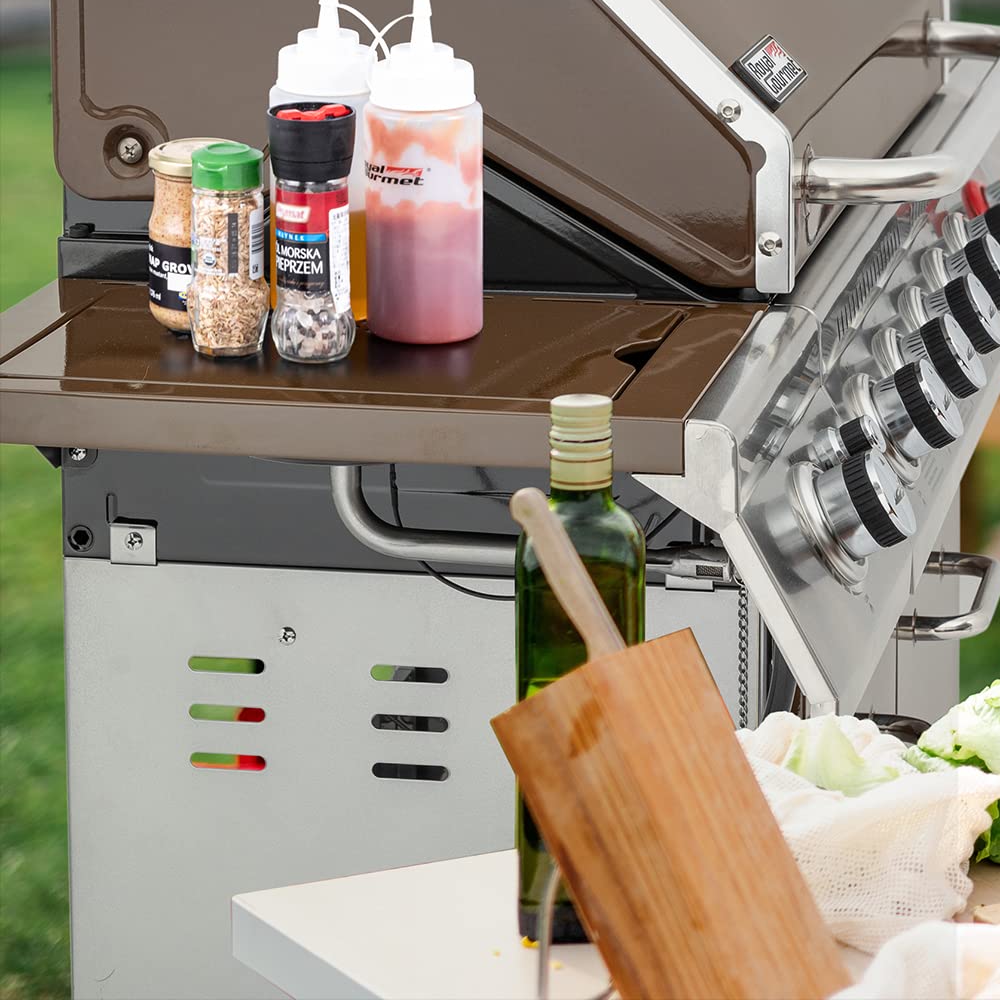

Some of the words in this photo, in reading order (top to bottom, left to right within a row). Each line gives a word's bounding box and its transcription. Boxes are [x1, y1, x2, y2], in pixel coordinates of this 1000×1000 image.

[747, 50, 776, 80] Royal
[764, 56, 802, 95] Gourmet
[366, 170, 425, 186] urmet
[280, 245, 321, 260] MORSKA
